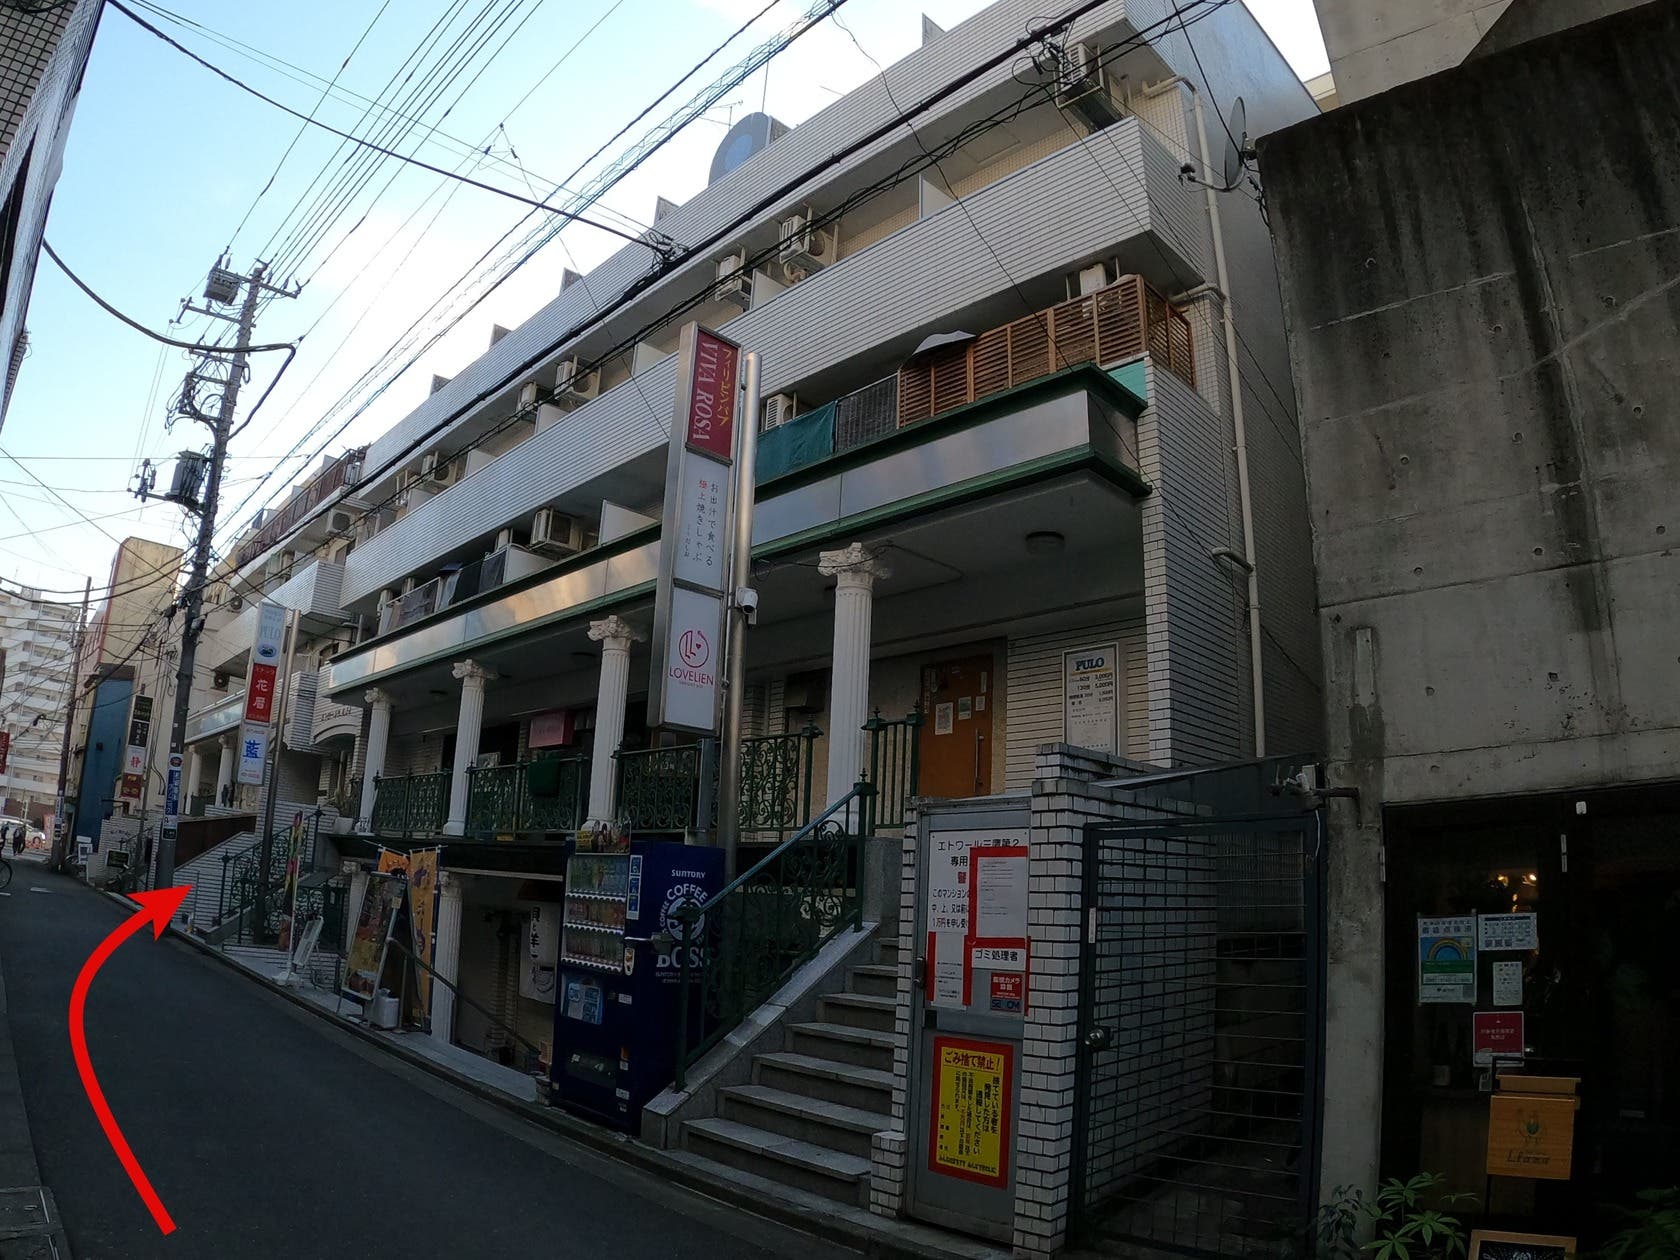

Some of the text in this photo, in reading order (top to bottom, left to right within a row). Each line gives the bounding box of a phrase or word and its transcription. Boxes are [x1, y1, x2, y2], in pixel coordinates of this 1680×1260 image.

[692, 341, 720, 441] VIVA ROSA
[1075, 657, 1105, 671] PULO
[669, 666, 714, 686] LOVELIEN
[950, 855, 969, 868] 専用
[671, 869, 706, 880] SUNTORY
[666, 883, 709, 903] COFFEE
